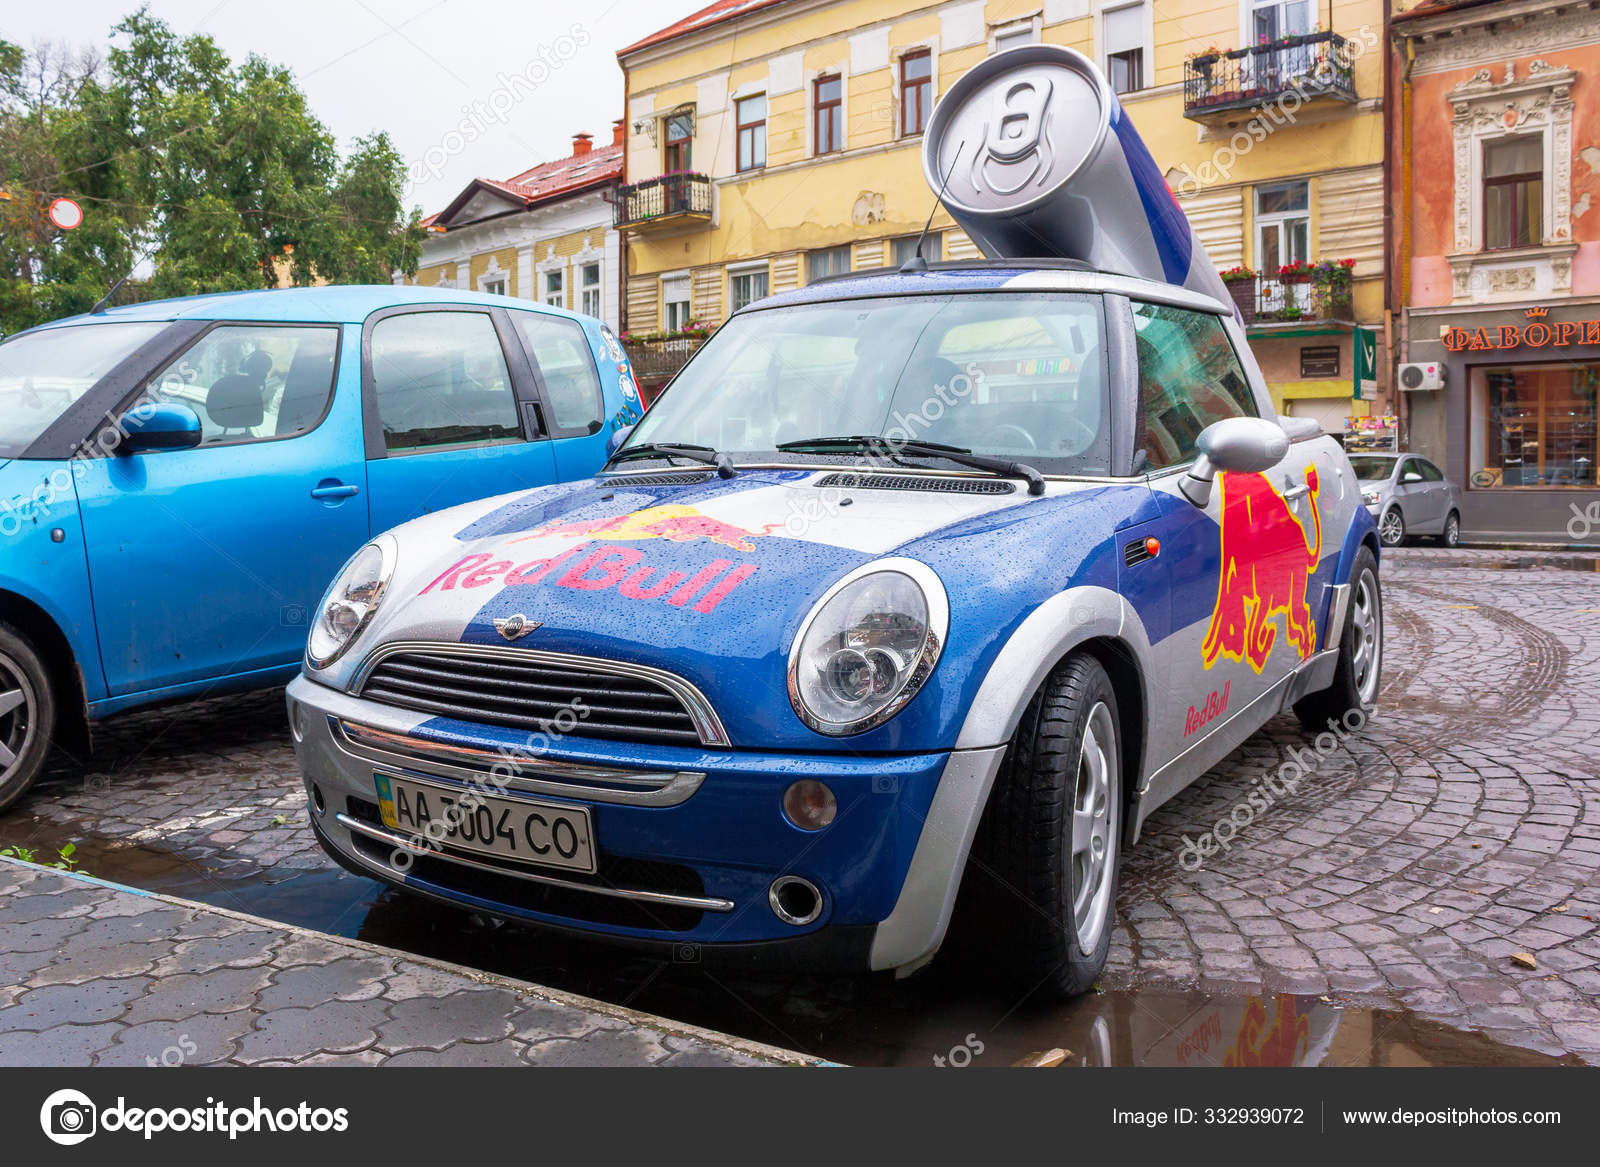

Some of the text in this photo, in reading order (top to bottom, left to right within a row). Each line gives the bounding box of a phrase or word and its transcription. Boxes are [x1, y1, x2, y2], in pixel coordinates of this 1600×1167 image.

[1441, 320, 1600, 351] ФАВОРИ
[417, 541, 759, 614] Red Bull
[504, 622, 522, 630] MINI
[524, 814, 578, 859] CO
